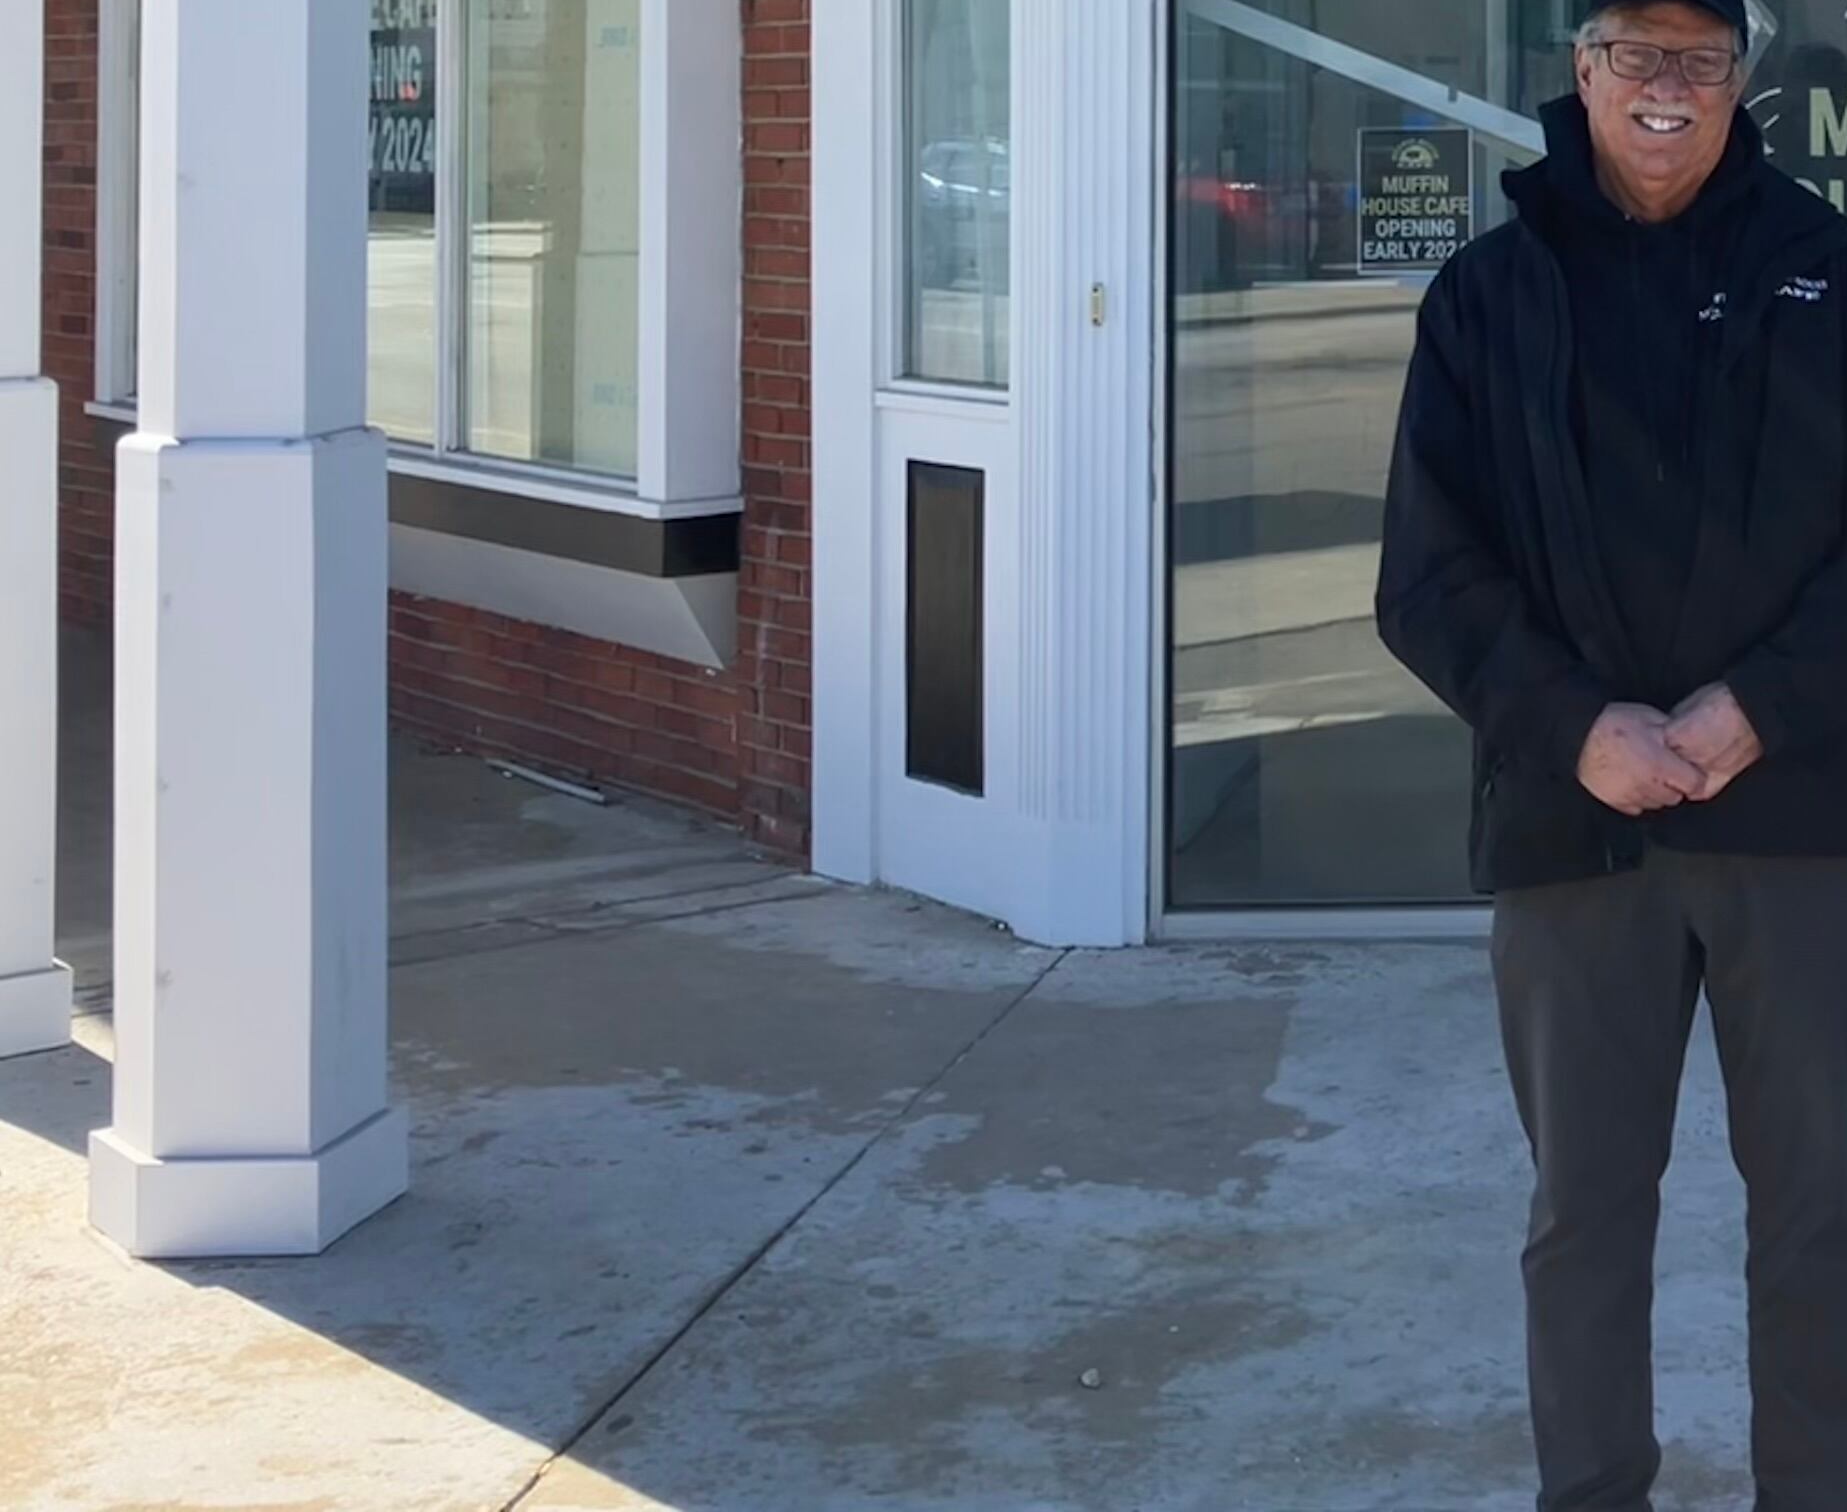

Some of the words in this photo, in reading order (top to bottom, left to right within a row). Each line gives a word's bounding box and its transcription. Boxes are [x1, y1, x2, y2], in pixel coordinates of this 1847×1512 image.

[382, 116, 436, 172] 2024
[1382, 175, 1449, 194] MUFFIN
[1361, 197, 1422, 216] HOUSE
[1424, 196, 1470, 215] CAFE
[1375, 218, 1457, 238] OPENING
[1363, 239, 1422, 260] EARLY
